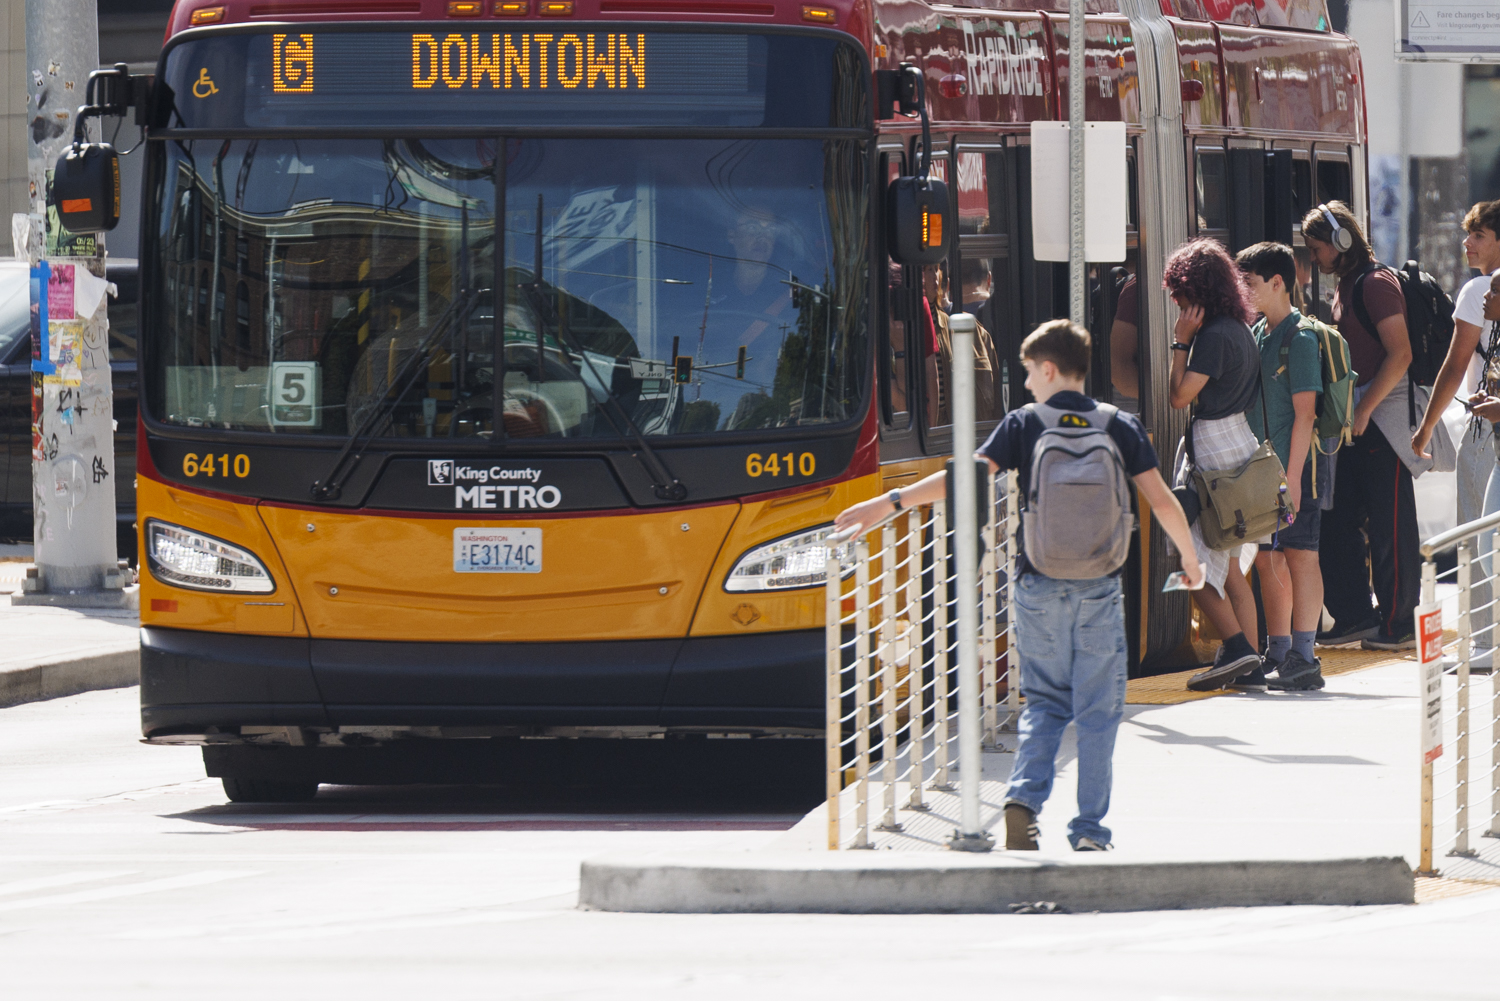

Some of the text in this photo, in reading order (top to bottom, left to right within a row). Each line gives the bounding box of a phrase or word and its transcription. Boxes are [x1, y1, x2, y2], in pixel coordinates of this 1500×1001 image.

[1437, 11, 1453, 19] Fare
[1454, 11, 1485, 20] changes
[412, 34, 645, 89] DOWNTOWN
[281, 373, 305, 403] 5
[182, 453, 250, 478] 6410
[455, 466, 542, 483] King County
[746, 452, 816, 477] 6410
[455, 485, 562, 509] METRO
[470, 544, 535, 567] E3174C
